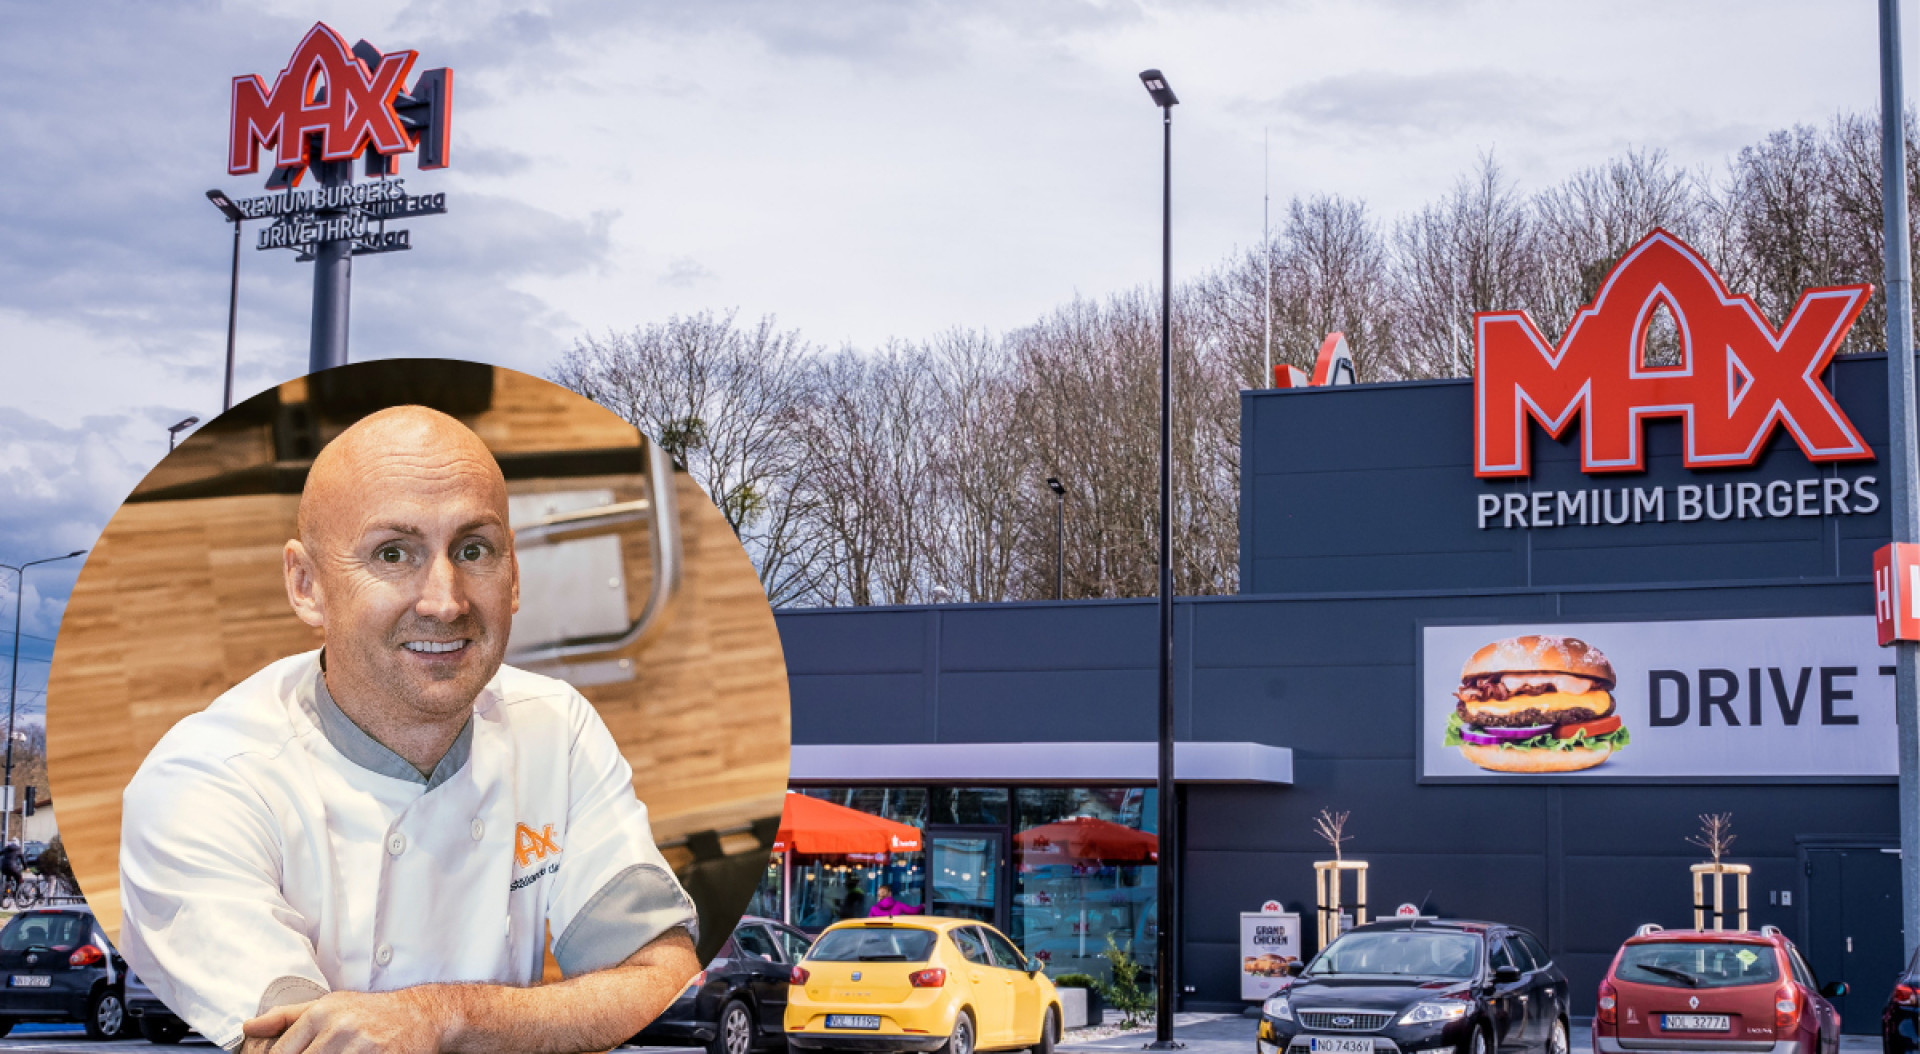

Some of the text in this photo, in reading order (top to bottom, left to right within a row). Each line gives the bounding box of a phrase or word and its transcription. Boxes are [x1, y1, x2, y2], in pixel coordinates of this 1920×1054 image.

[228, 21, 419, 175] MAX
[314, 178, 406, 209] BURGERS
[257, 223, 313, 249] DRIVE
[316, 216, 369, 241] THRU
[1474, 227, 1876, 478] MAX
[1478, 476, 1880, 529] PREMIUM BURGERS
[1648, 666, 1860, 727] DRIVE
[514, 822, 562, 868] AX
[1253, 935, 1288, 945] CHICKEN
[1694, 1016, 1728, 1029] 3277A
